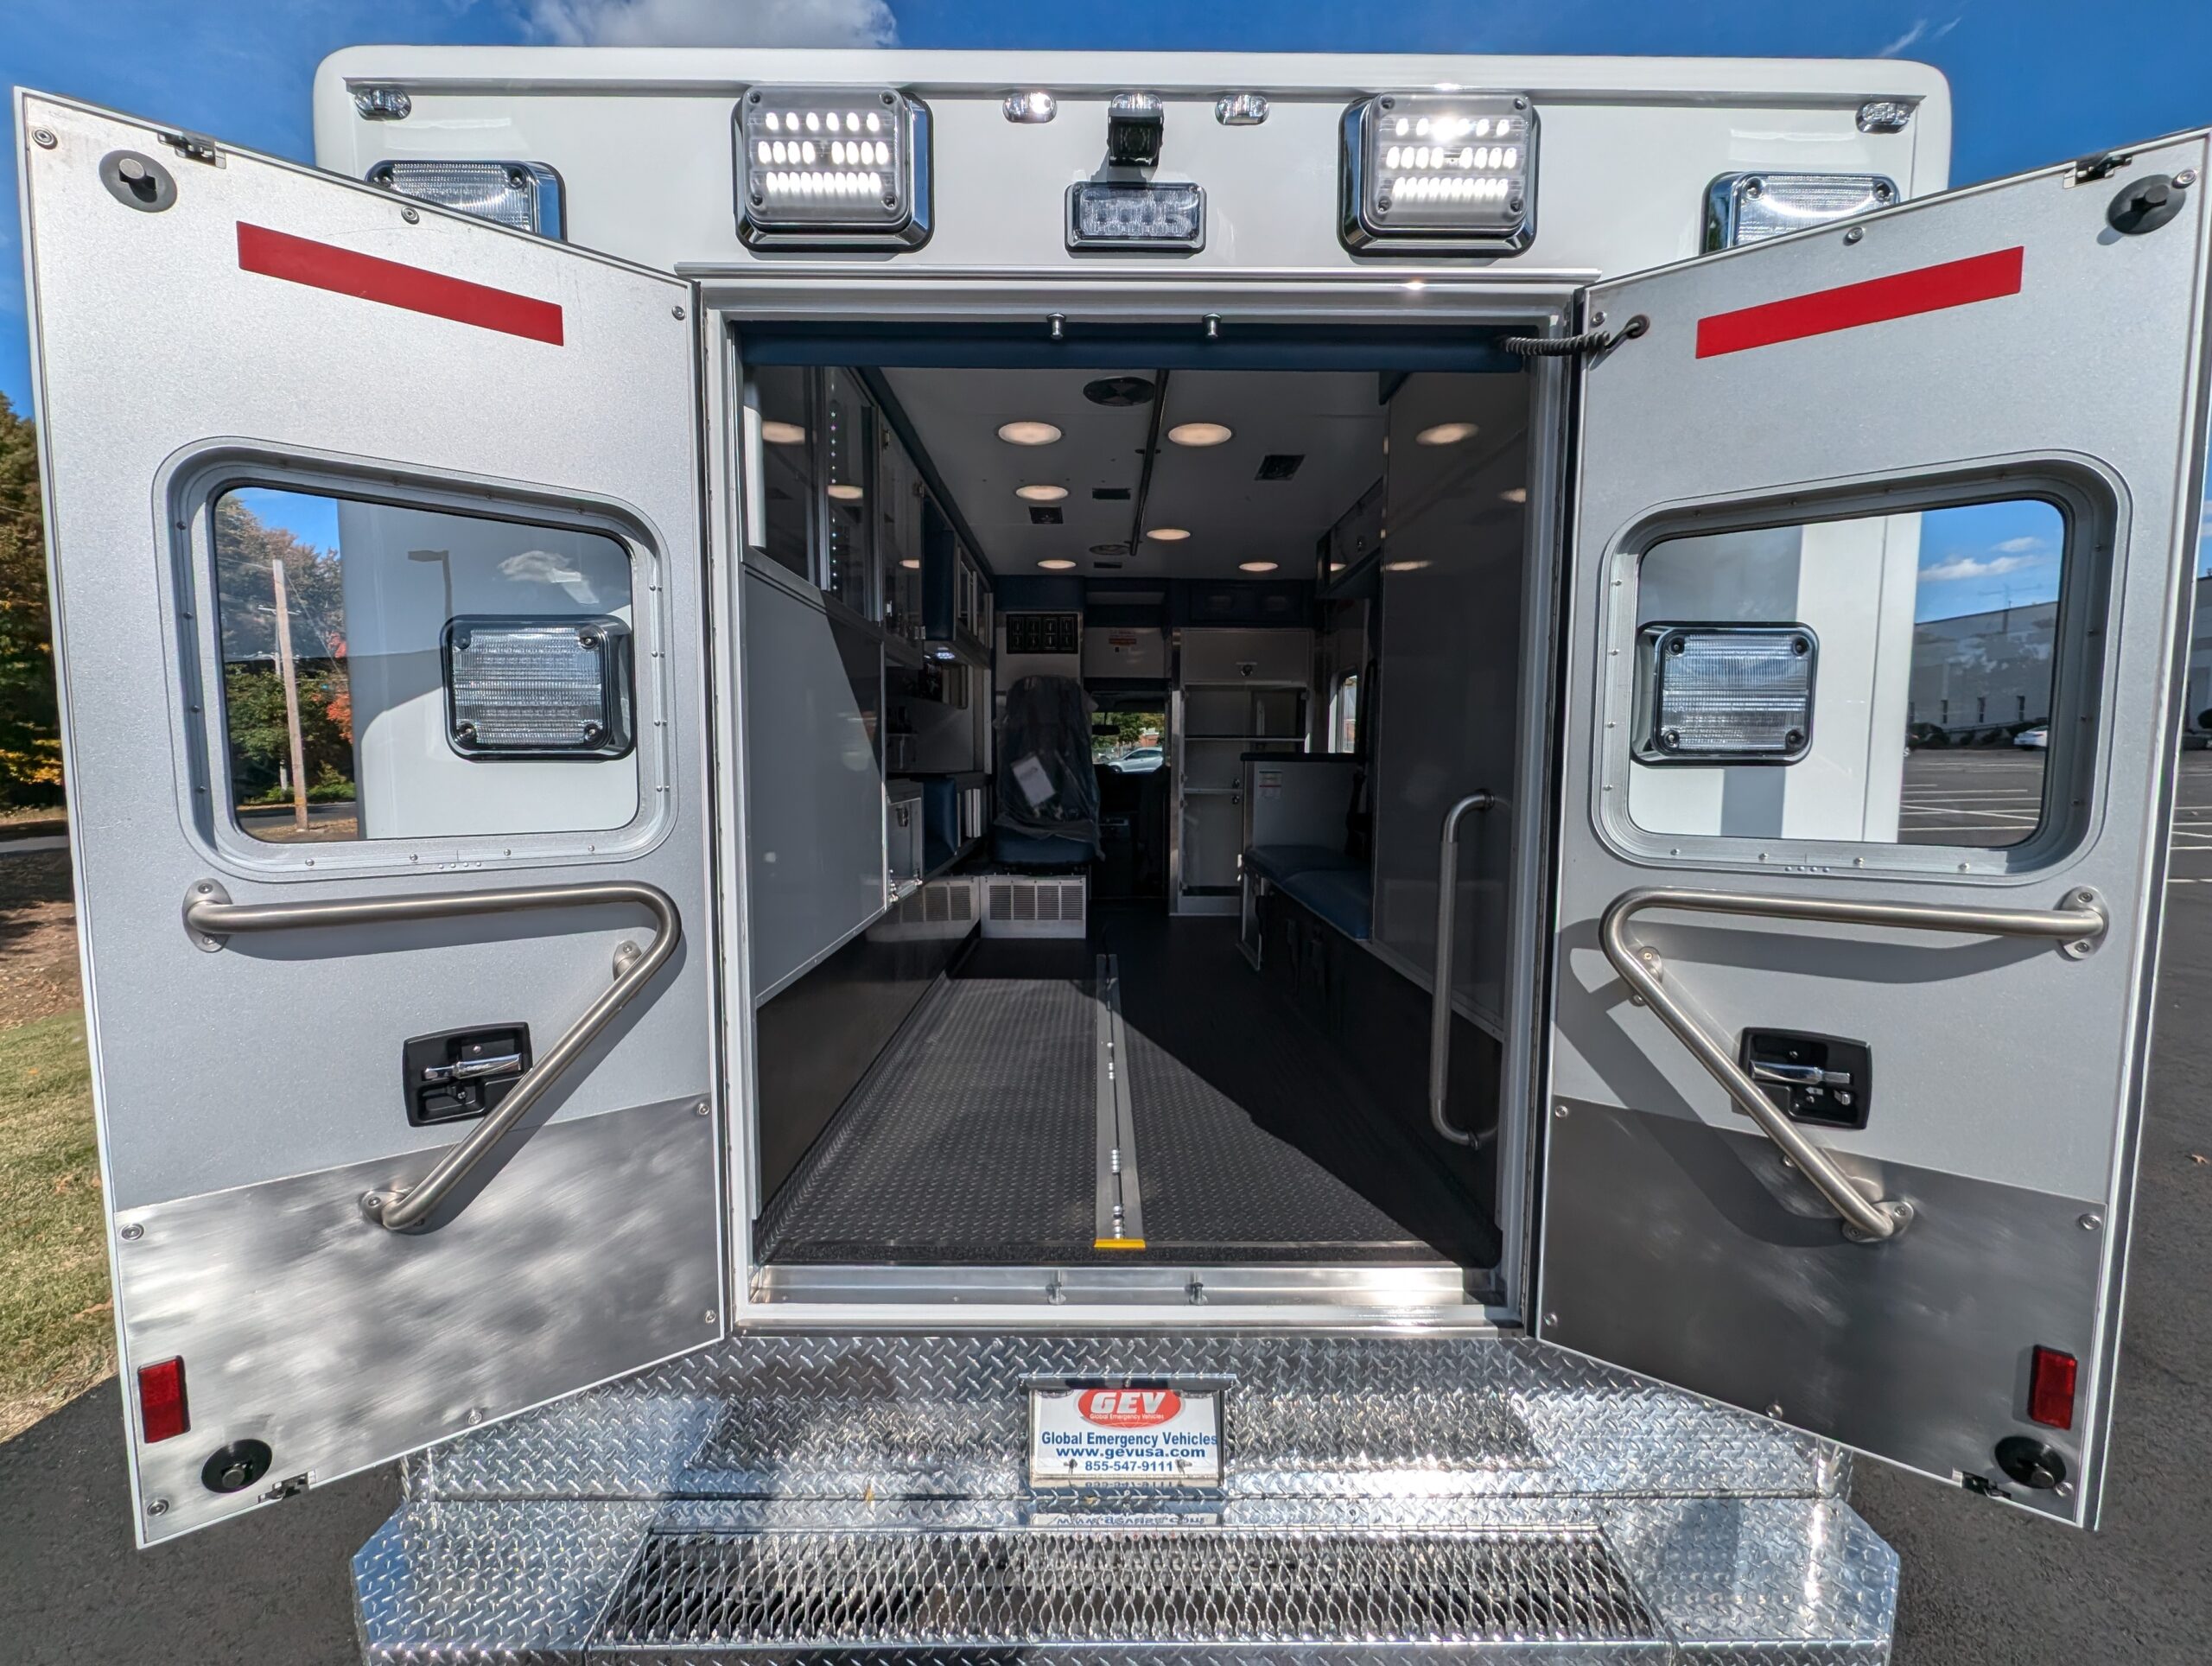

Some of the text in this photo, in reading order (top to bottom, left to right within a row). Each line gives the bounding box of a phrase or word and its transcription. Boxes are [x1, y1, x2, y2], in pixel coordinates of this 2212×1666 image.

[1090, 1391, 1166, 1414] GEV
[1109, 1413, 1141, 1421] Emergency
[1041, 1431, 1217, 1447] Global Emergency Vehicles
[1056, 1447, 1205, 1459] www.gevusa.com
[1084, 1460, 1173, 1472] 855-547-9111
